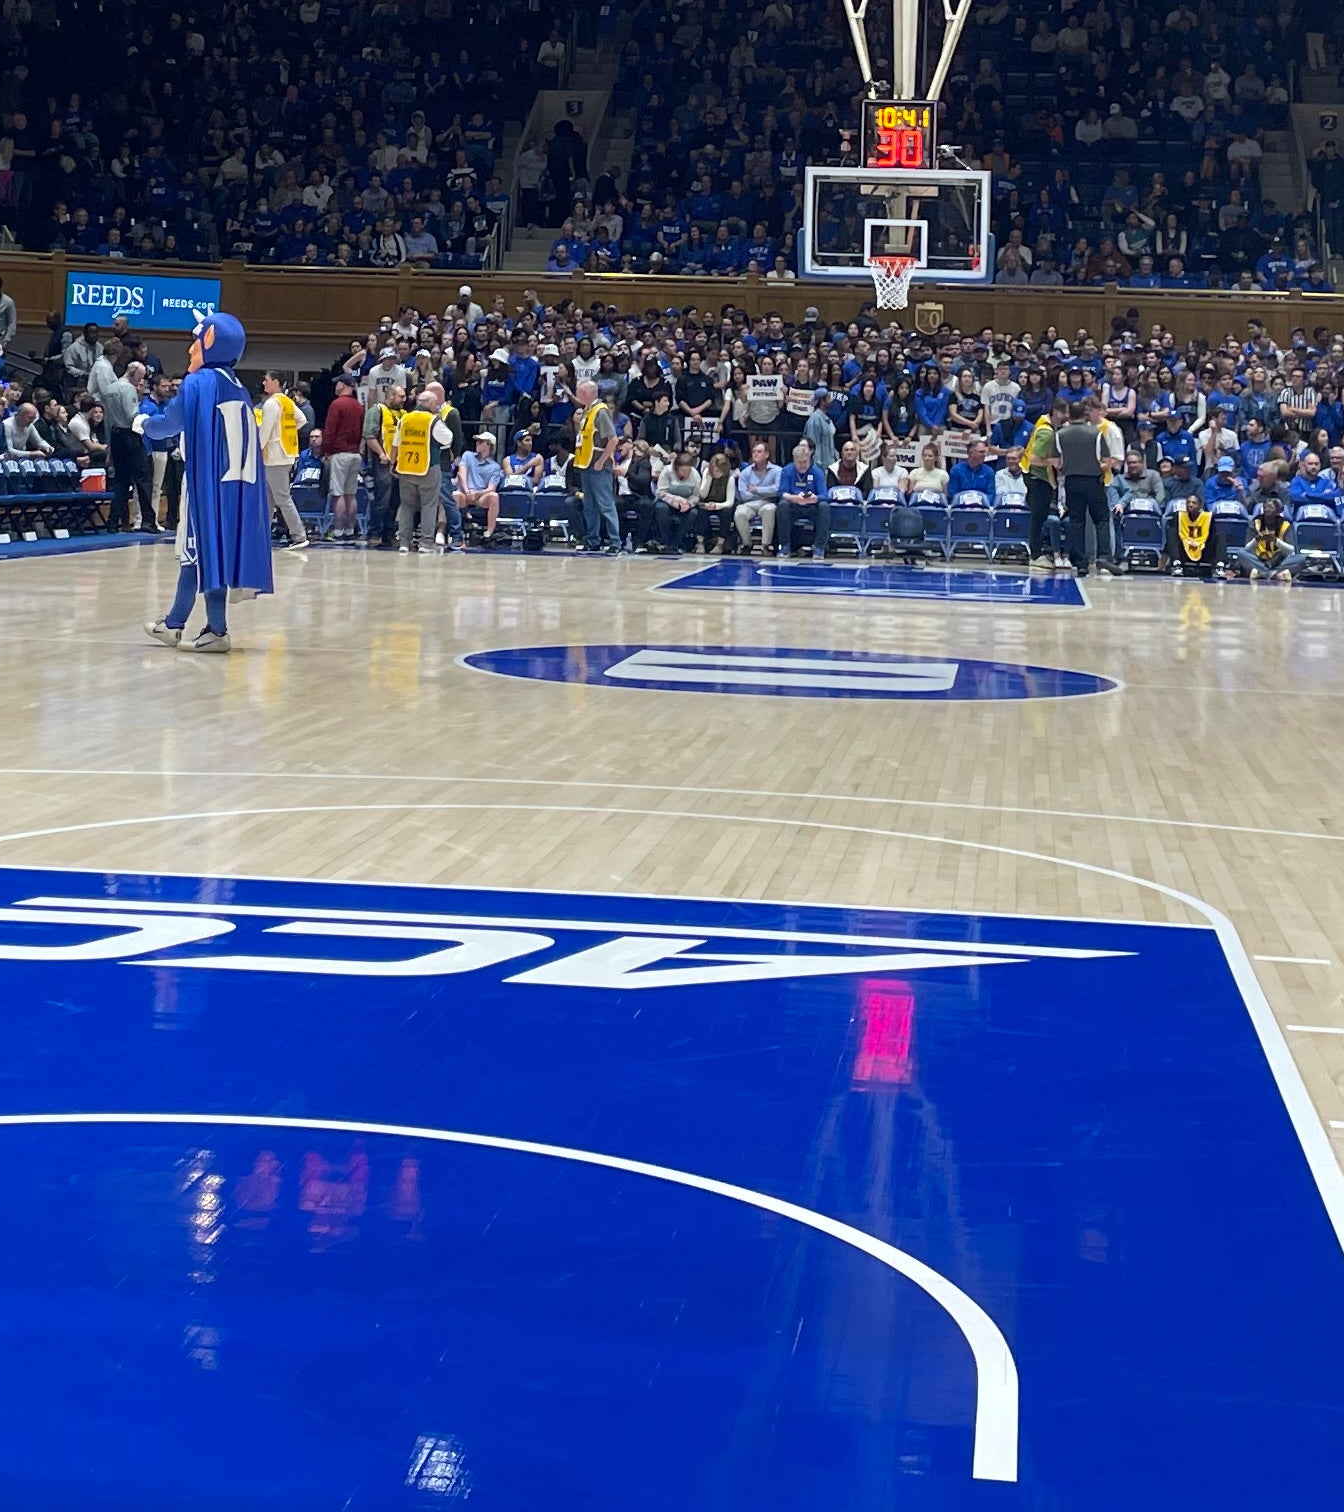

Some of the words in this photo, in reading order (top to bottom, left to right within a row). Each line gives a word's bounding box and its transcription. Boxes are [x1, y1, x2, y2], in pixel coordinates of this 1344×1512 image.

[877, 128, 923, 168] 30
[72, 283, 144, 307] REEDS
[162, 298, 216, 310] REEDS.com
[751, 377, 779, 388] PAW
[406, 451, 420, 465] 73
